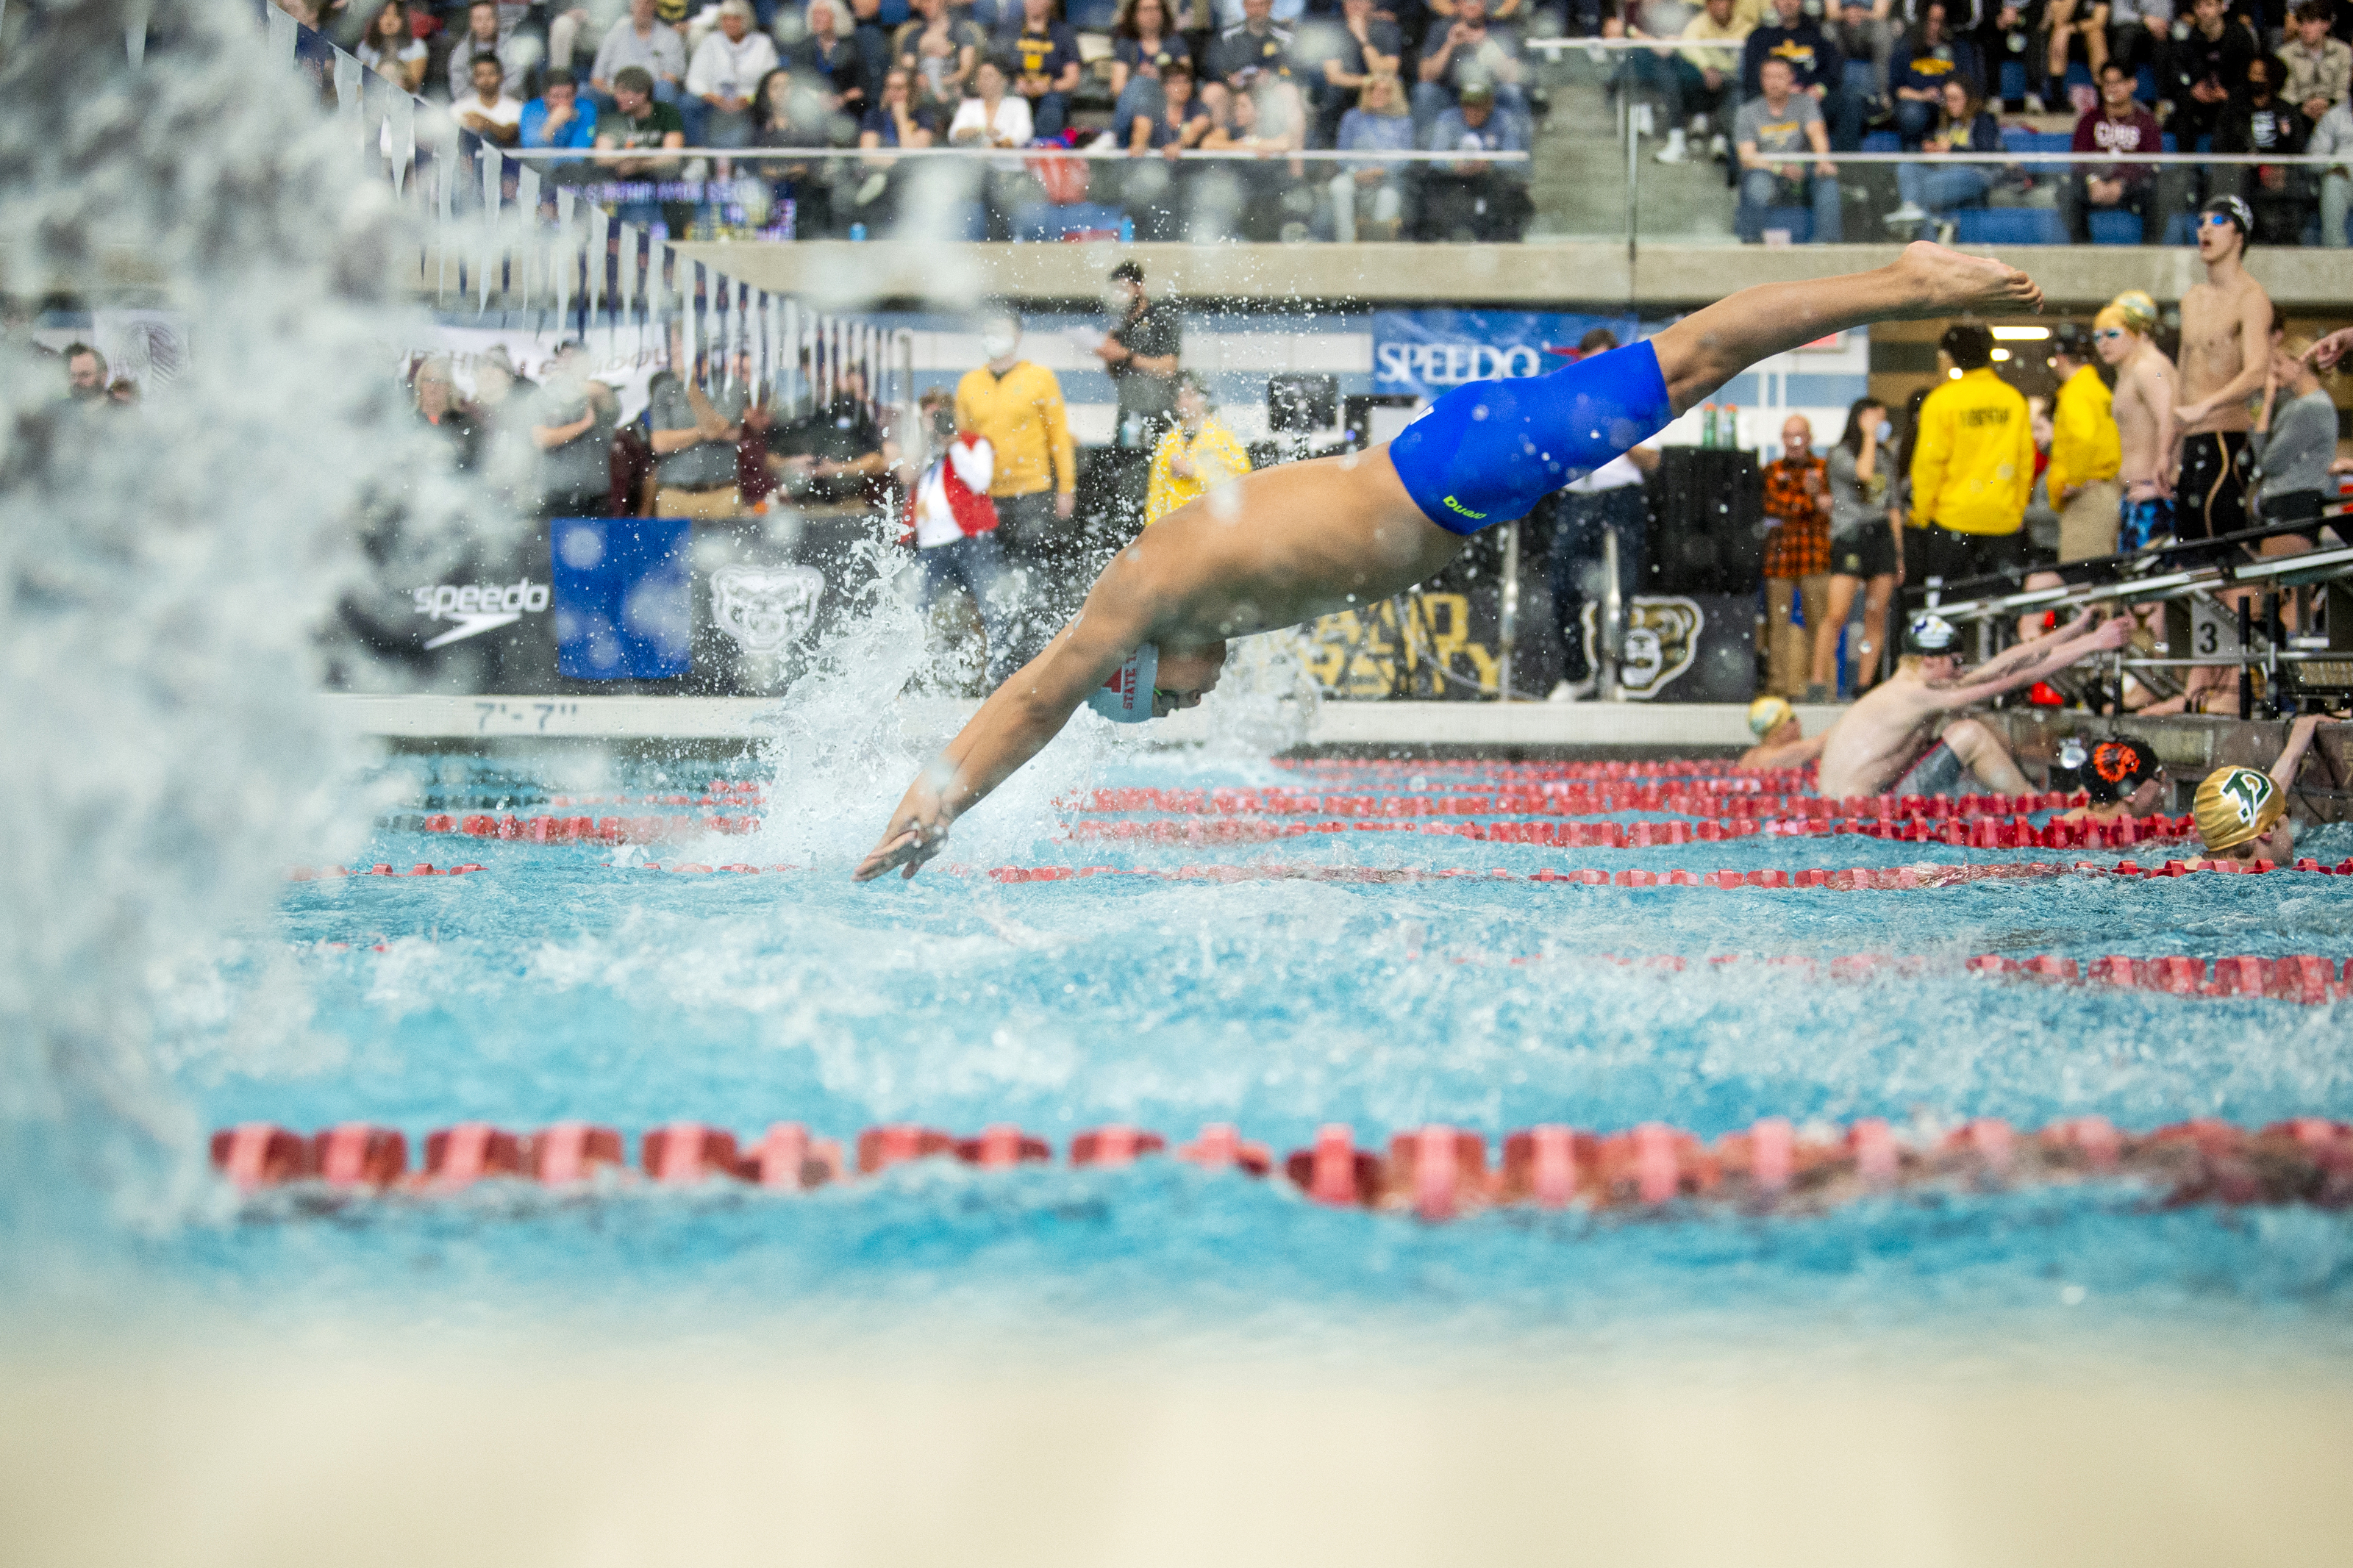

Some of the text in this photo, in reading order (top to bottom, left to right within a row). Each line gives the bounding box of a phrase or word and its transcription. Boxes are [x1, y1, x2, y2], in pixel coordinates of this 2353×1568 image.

[1377, 342, 1540, 384] SPEEDO
[413, 576, 550, 621] speedo
[2199, 620, 2218, 654] 3
[1122, 667, 1136, 710] STATE
